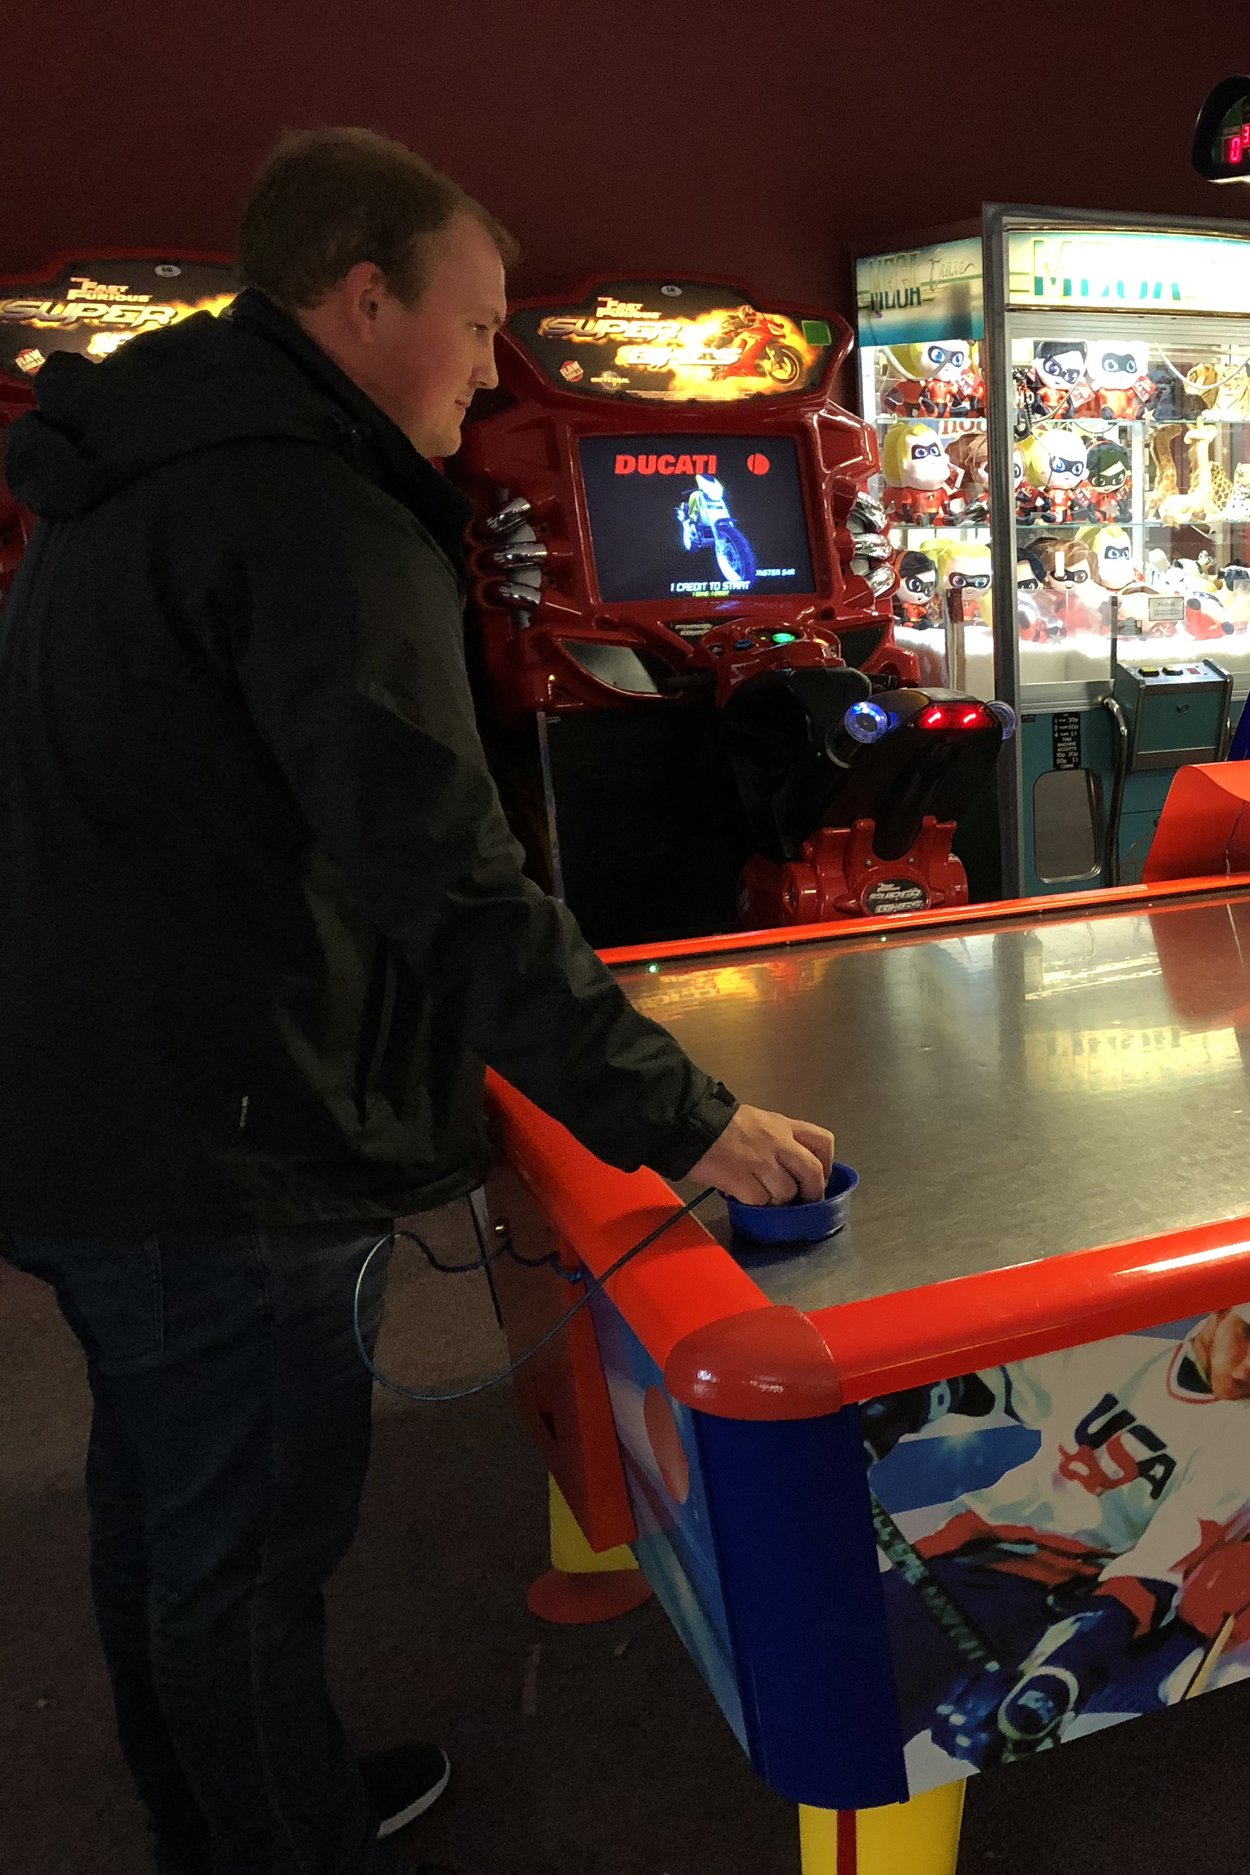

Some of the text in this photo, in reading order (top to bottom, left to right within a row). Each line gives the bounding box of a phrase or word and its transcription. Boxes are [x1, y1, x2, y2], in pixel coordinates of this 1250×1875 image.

[1, 301, 178, 328] SUPER
[547, 318, 683, 342] SUPER
[614, 454, 717, 475] DUCATI
[676, 582, 708, 592] CREDIT
[709, 581, 721, 591] TO
[1058, 1393, 1177, 1500] USA
